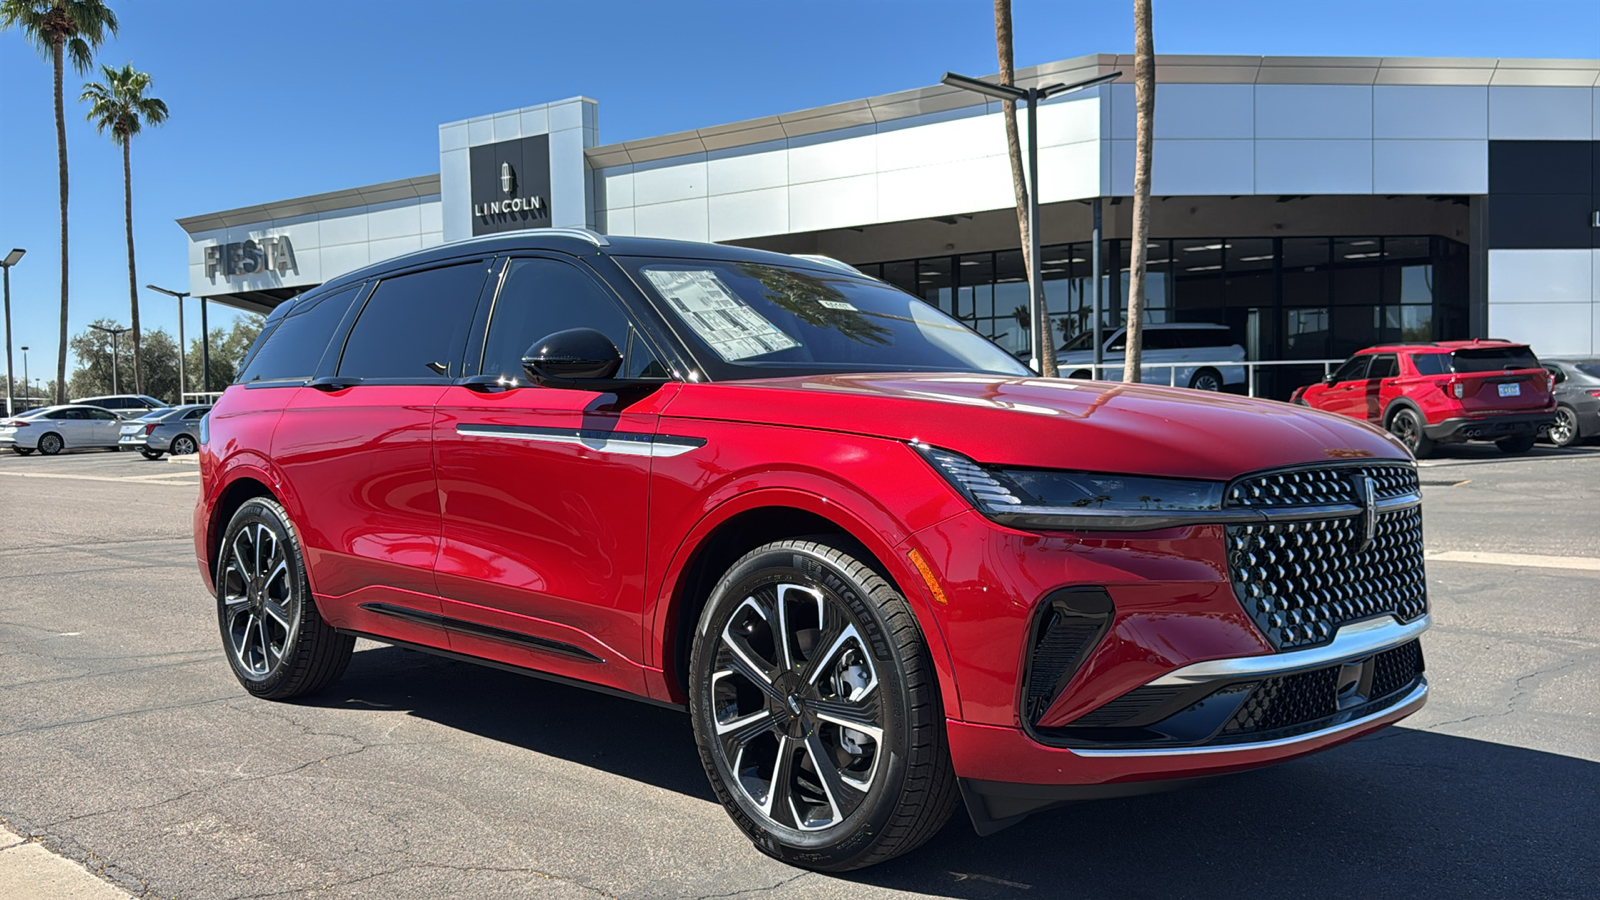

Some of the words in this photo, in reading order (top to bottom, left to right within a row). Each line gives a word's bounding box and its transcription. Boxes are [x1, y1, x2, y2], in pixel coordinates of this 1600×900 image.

[474, 196, 540, 217] LINCOLN
[204, 235, 295, 278] FIESTA
[825, 574, 888, 656] MICHELIN
